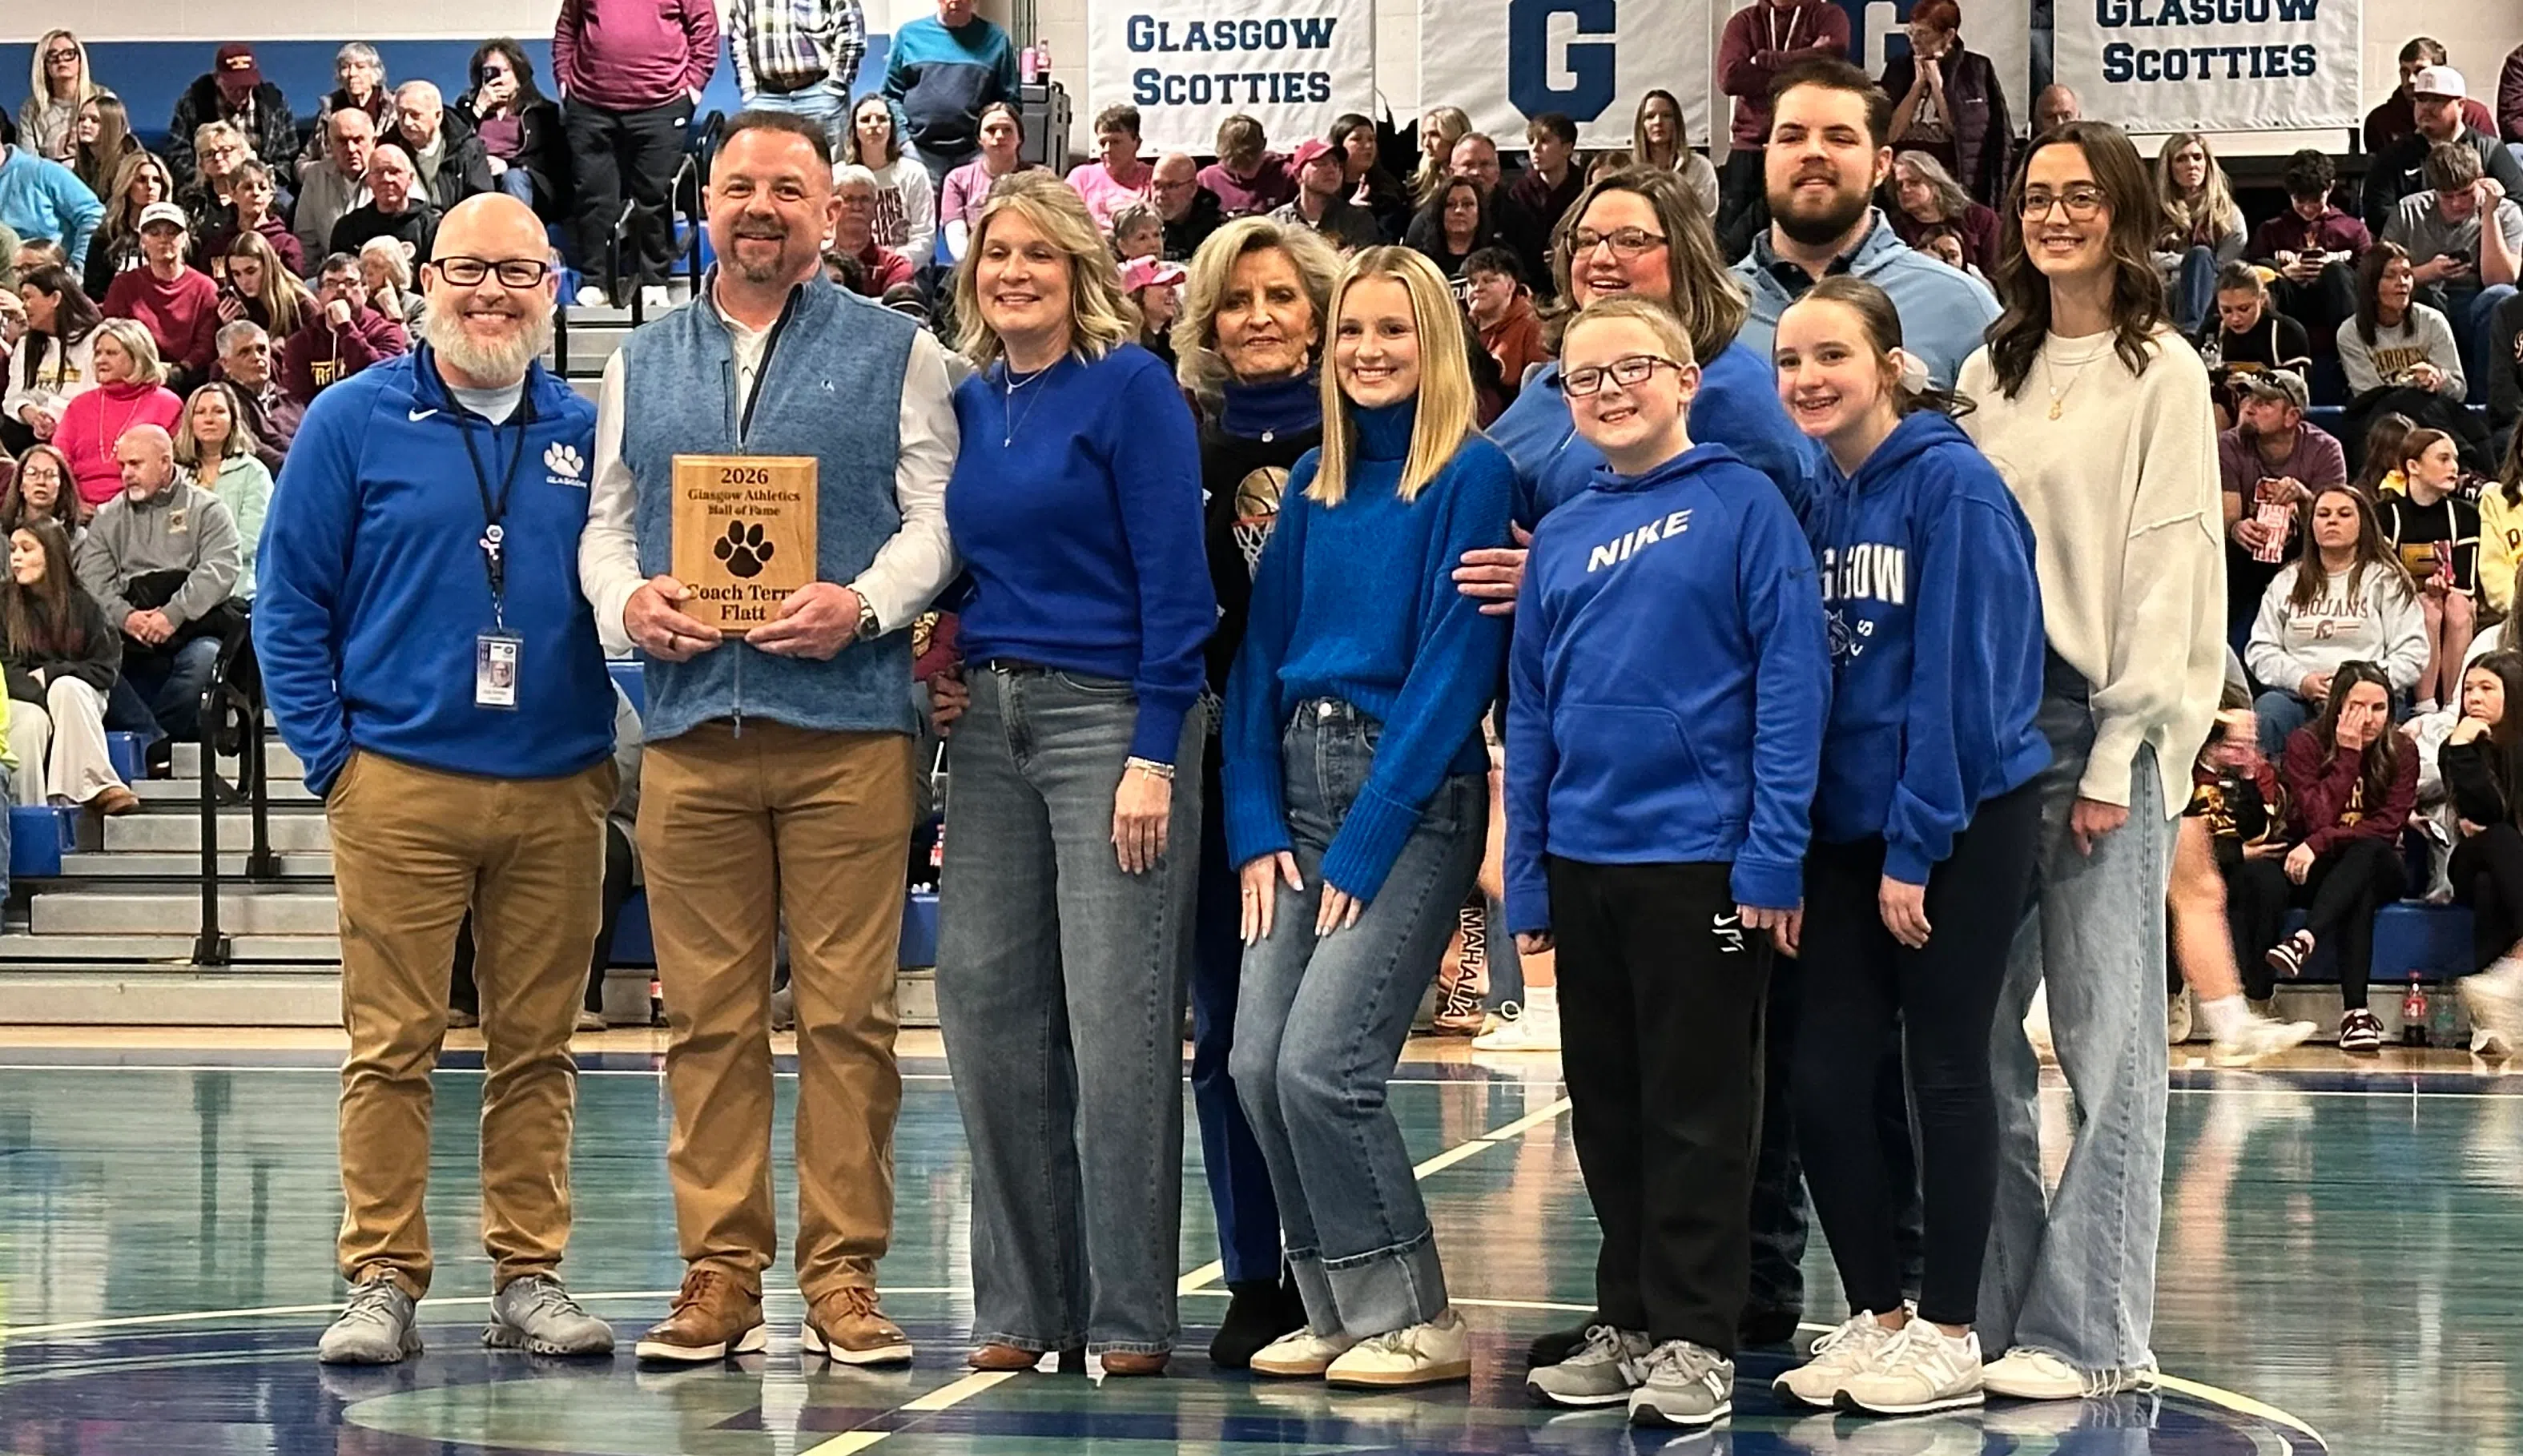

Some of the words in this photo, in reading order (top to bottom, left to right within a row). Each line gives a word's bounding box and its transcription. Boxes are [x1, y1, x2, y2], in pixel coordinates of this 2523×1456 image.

[2096, 0, 2320, 28] GLASGOW
[1127, 14, 1337, 52] GLASGOW
[2102, 42, 2316, 83] SCOTTIES
[1133, 68, 1330, 106] SCOTTIES
[721, 468, 769, 485] 2026
[688, 489, 741, 503] Glasgow
[744, 489, 800, 501] Athletics
[708, 505, 732, 516] Hall
[734, 505, 747, 516] of
[749, 505, 781, 516] Fame
[1587, 509, 1694, 573] NIKE
[686, 584, 743, 601] Coach
[748, 584, 797, 601] Terr
[721, 604, 767, 621] Flatt
[1442, 907, 1487, 1020] MAHALIA
